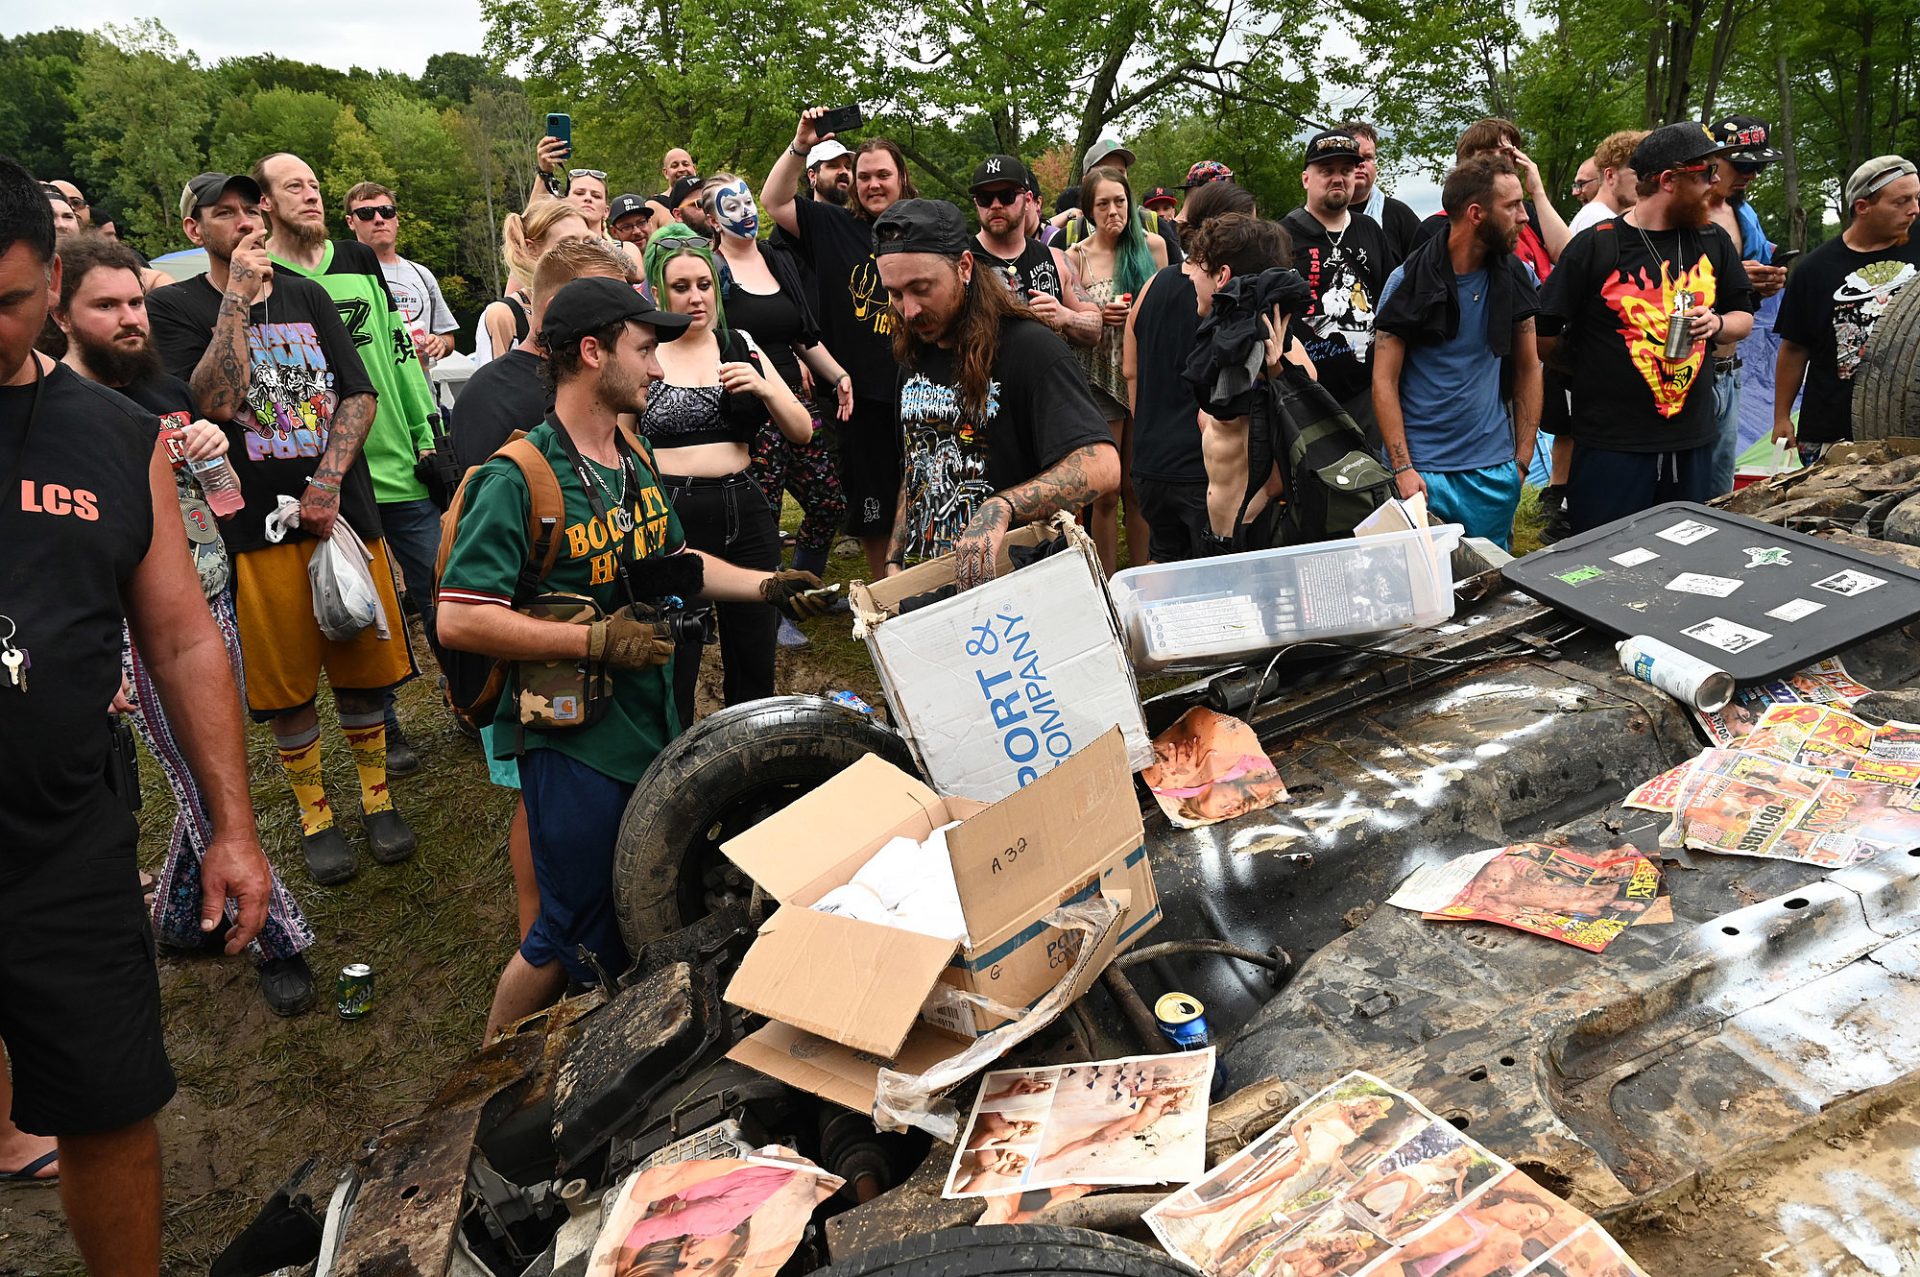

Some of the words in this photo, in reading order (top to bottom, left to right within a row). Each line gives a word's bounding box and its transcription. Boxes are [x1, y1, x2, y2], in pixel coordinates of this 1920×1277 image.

[986, 159, 1001, 174] NY
[21, 479, 100, 521] LCS
[565, 486, 668, 559] BOUTY
[965, 618, 999, 656] &
[996, 613, 1072, 768] OMPANY
[1768, 707, 1820, 722] 69
[991, 857, 1002, 875] A
[1004, 837, 1028, 863] 32
[990, 964, 1003, 980] G
